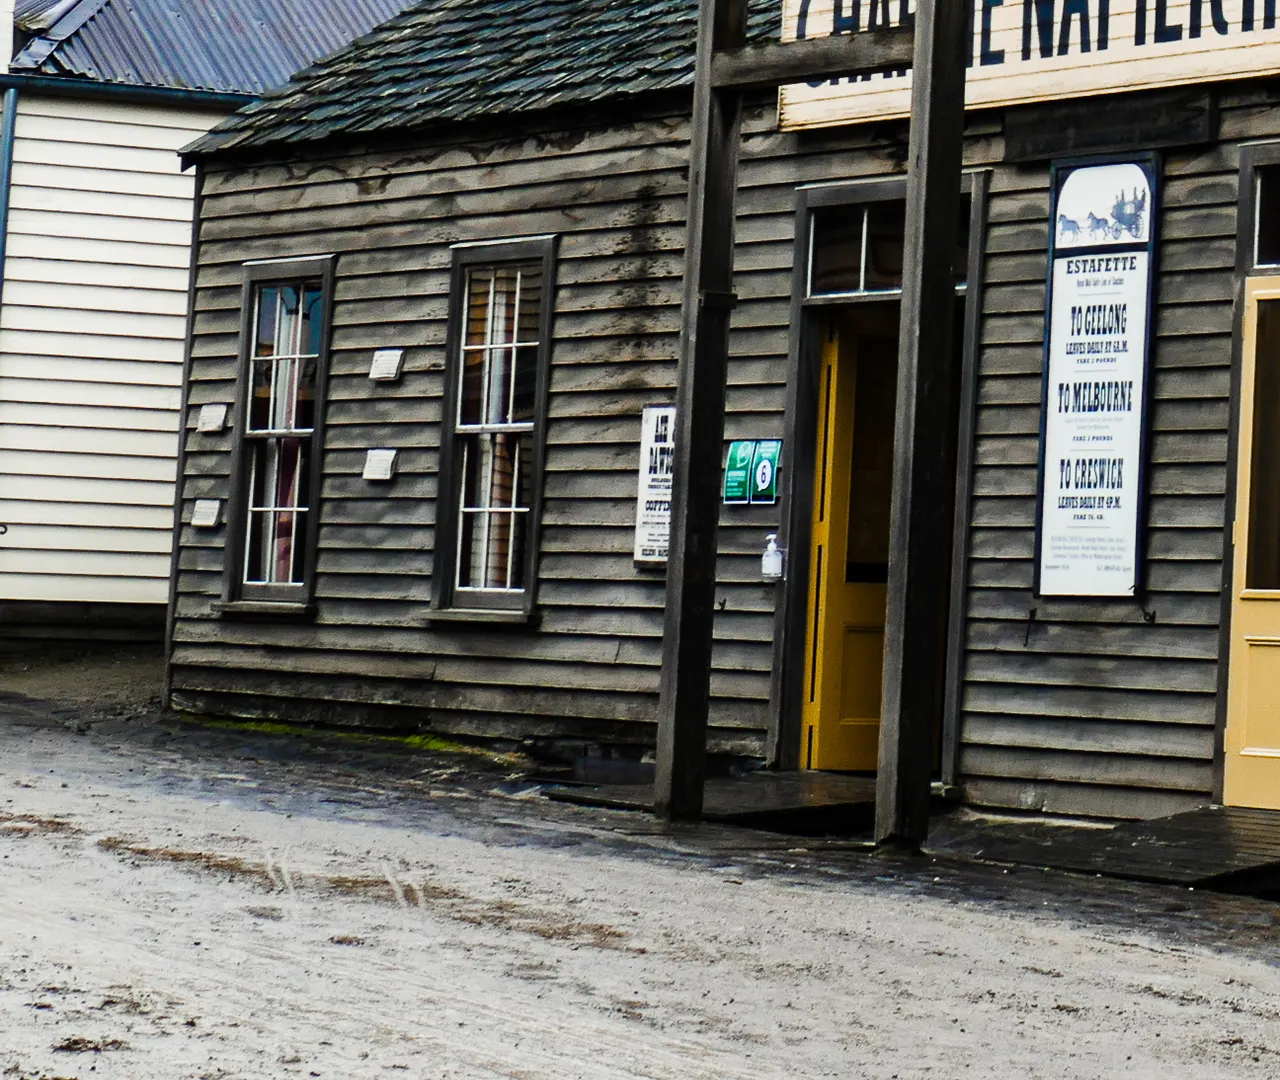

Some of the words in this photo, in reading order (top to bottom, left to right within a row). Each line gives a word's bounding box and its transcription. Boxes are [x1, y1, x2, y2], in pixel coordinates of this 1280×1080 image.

[1066, 256, 1137, 274] ESTAFETTE
[1071, 306, 1082, 336] TO
[1084, 304, 1127, 336] GEELONG
[1066, 342, 1086, 355] LEAVES
[1087, 341, 1104, 354] DAILY
[1105, 341, 1112, 354] AT
[1058, 383, 1070, 414] TO
[1072, 380, 1133, 412] MELBOURNE
[1060, 458, 1071, 489] TO
[1074, 458, 1124, 489] CRESWICK
[1058, 497, 1078, 509] LEAVES
[1080, 496, 1097, 509] DAILY
[1097, 496, 1105, 509] AT
